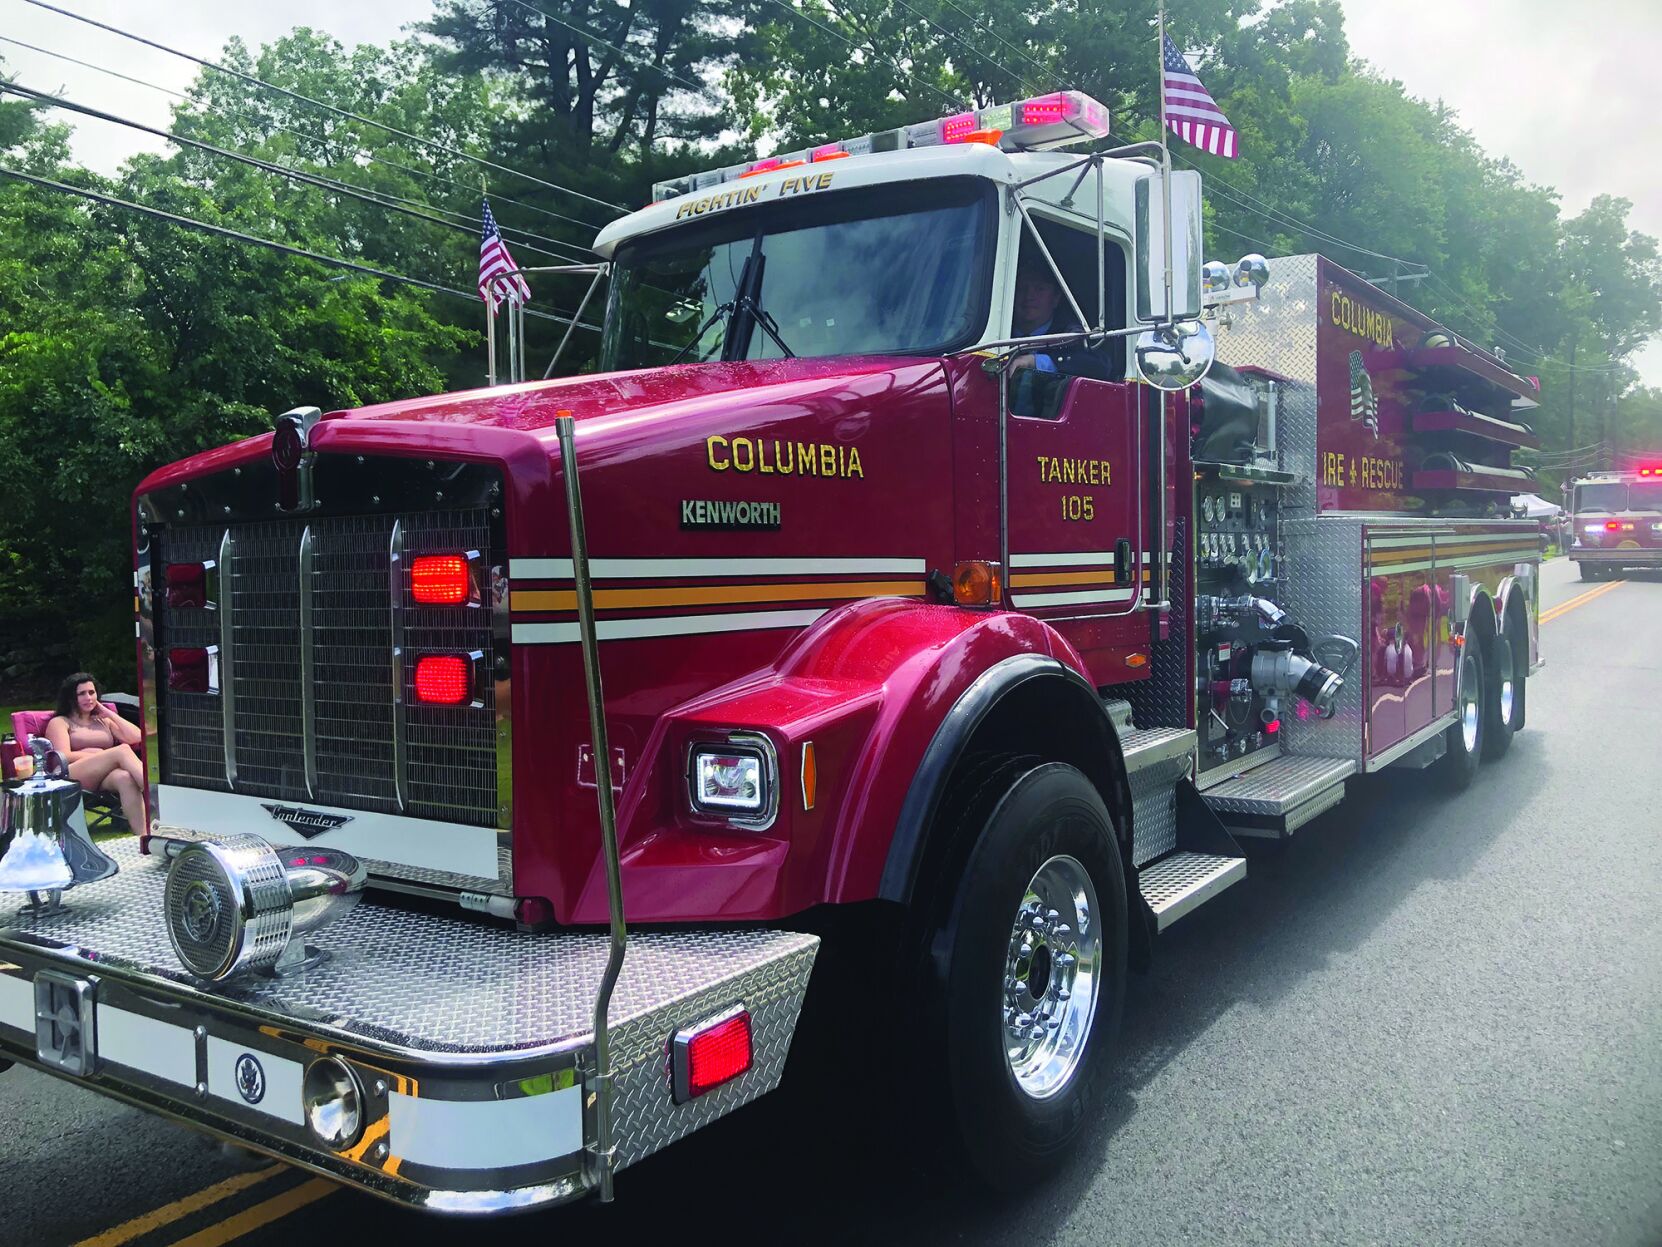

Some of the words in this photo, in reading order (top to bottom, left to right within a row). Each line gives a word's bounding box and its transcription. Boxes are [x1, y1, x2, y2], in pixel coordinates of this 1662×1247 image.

[675, 183, 768, 220] FIGHTIN'
[780, 171, 835, 196] FIVE
[1331, 291, 1393, 346] COLUMBIA
[706, 434, 865, 480] COLUMBIA
[1037, 456, 1111, 486] TANKER
[1322, 451, 1345, 487] IRE
[1361, 456, 1404, 489] RESCUE
[681, 500, 781, 526] KENWORTH
[1061, 495, 1094, 521] 105
